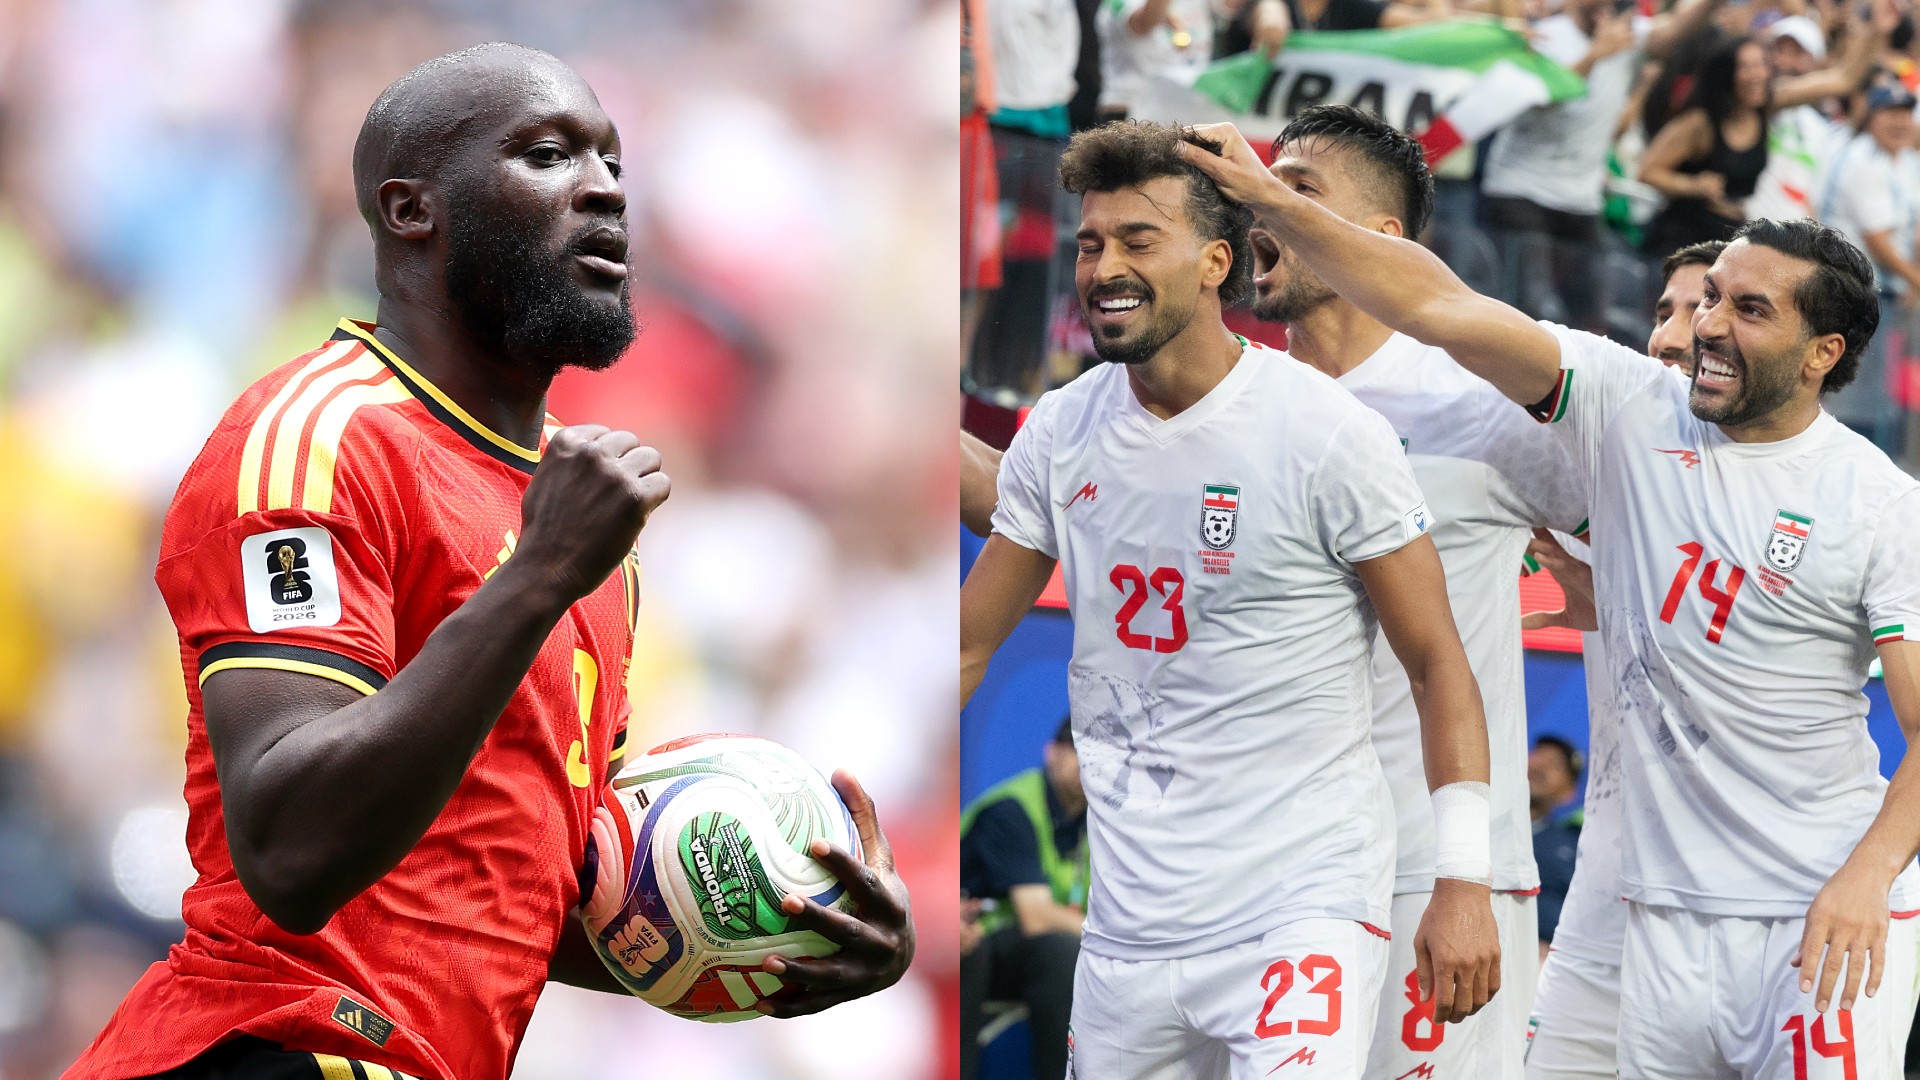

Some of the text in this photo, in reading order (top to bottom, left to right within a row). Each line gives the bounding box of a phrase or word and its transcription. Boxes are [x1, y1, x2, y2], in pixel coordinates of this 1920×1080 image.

[273, 612, 316, 621] 2026
[283, 590, 303, 600] FIFA
[1109, 564, 1189, 654] 23
[1659, 541, 1746, 645] 14
[691, 837, 732, 927] TRIONDA
[641, 925, 658, 945] FIFA
[1254, 953, 1342, 1040] 23
[1401, 967, 1445, 1052] 8
[1780, 1009, 1858, 1080] 14
